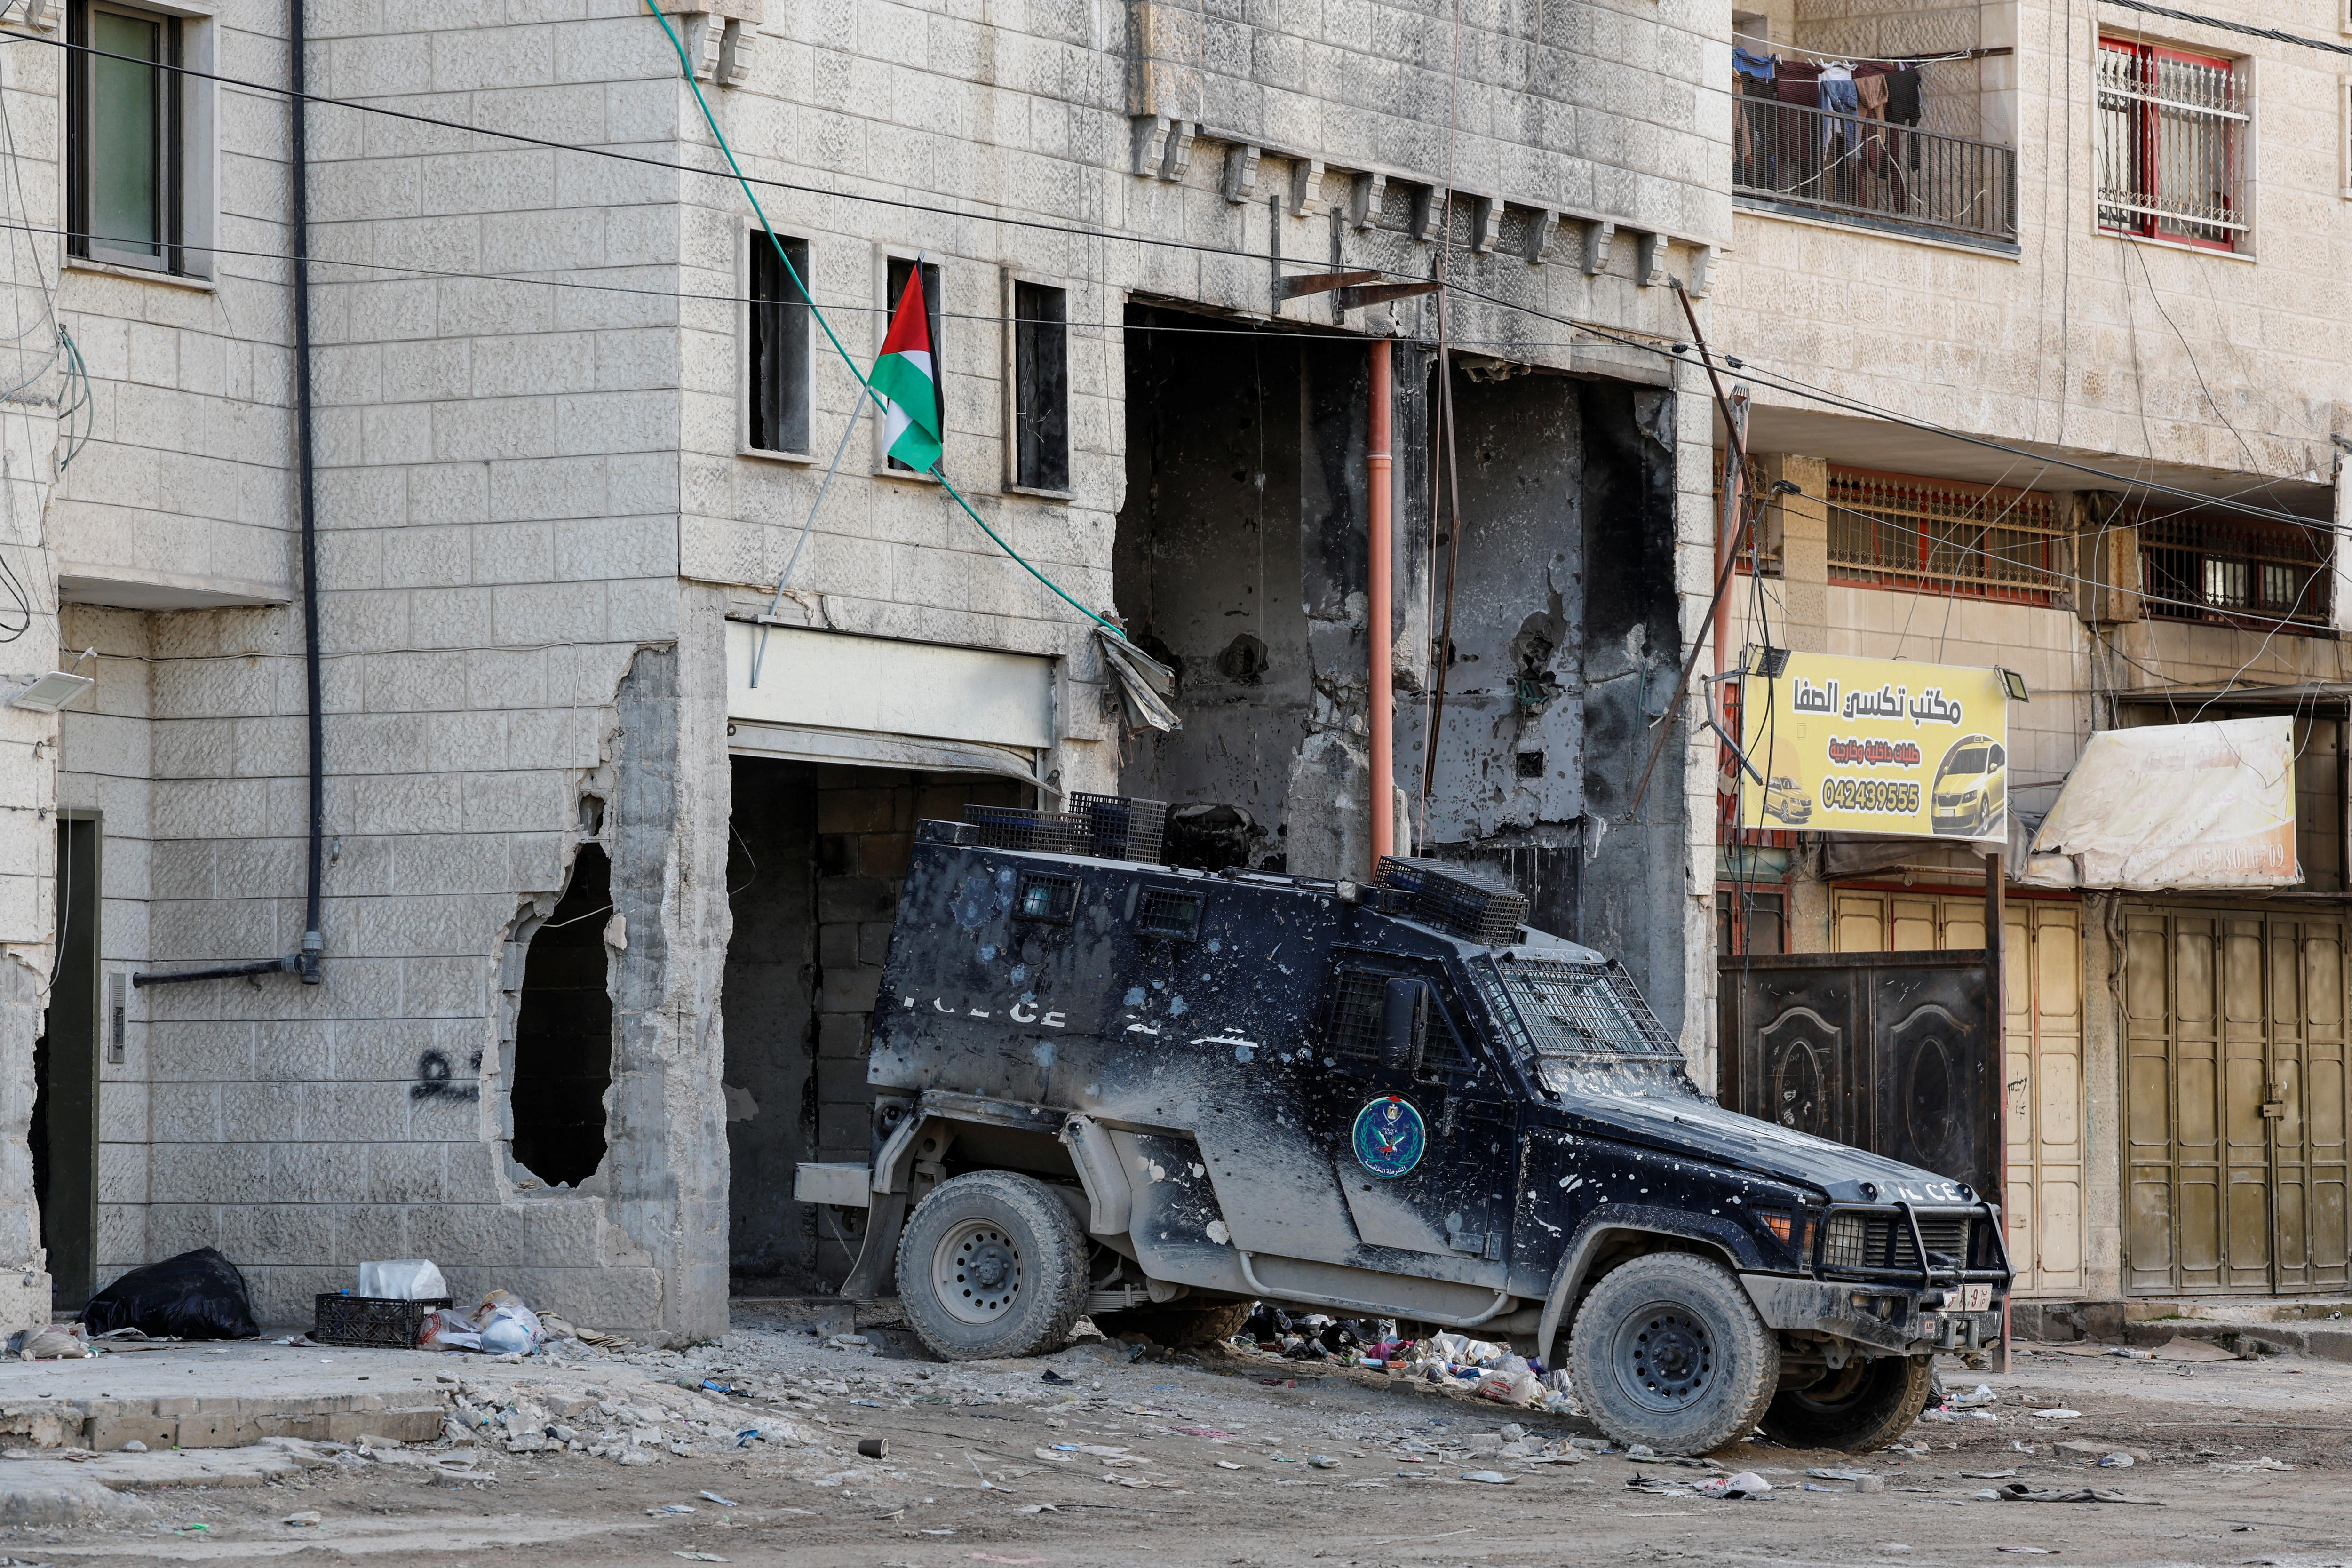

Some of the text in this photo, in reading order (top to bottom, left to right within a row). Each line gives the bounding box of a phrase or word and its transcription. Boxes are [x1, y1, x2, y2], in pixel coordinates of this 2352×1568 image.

[1794, 679, 1961, 725] مكتب تكسي الصفا
[1829, 738, 1920, 767] طلبات داخلية وخارجية
[1823, 779, 1920, 812] 042439555
[1365, 1158, 1406, 1175] الشرطة الخاصة
